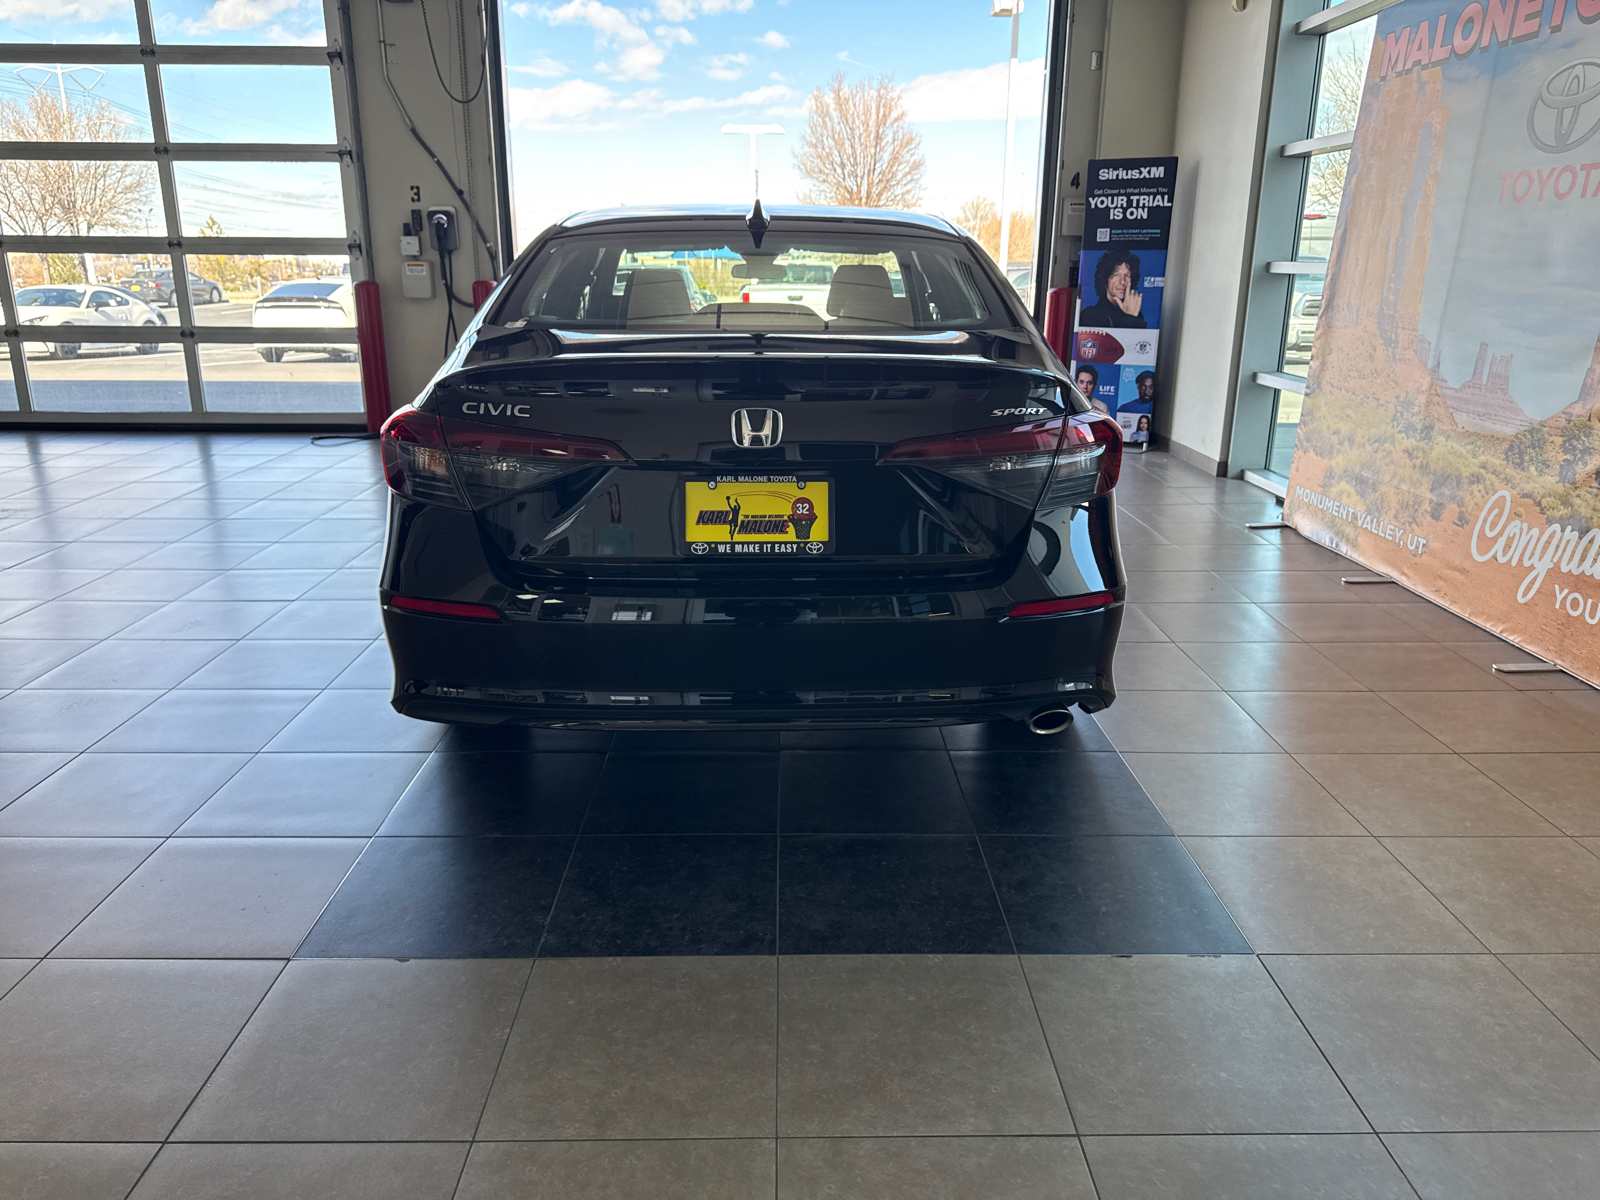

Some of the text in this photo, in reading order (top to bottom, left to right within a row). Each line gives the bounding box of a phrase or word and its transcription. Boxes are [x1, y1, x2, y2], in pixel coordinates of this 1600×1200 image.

[1379, 0, 1543, 80] MALONE
[1070, 171, 1081, 190] 4
[1098, 166, 1165, 180] SiriusXM
[1499, 162, 1600, 204] TOYOT
[410, 185, 421, 203] 3
[1088, 196, 1127, 209] YOUR
[1130, 195, 1172, 208] TRIAL
[1110, 207, 1148, 220] IS ON
[1081, 347, 1096, 359] NFL
[462, 402, 531, 418] CIVIC
[989, 407, 1048, 417] SPORT
[716, 475, 797, 483] KARL MALONE TOYOTA
[796, 503, 810, 515] 32
[695, 510, 732, 526] KARL
[1295, 485, 1427, 554] MONUMENT VALLEY, UT
[737, 519, 790, 535] MALONE
[717, 543, 798, 553] WE MAKE IT EASY
[1471, 490, 1600, 604] Congra
[1554, 584, 1600, 625] YOU
